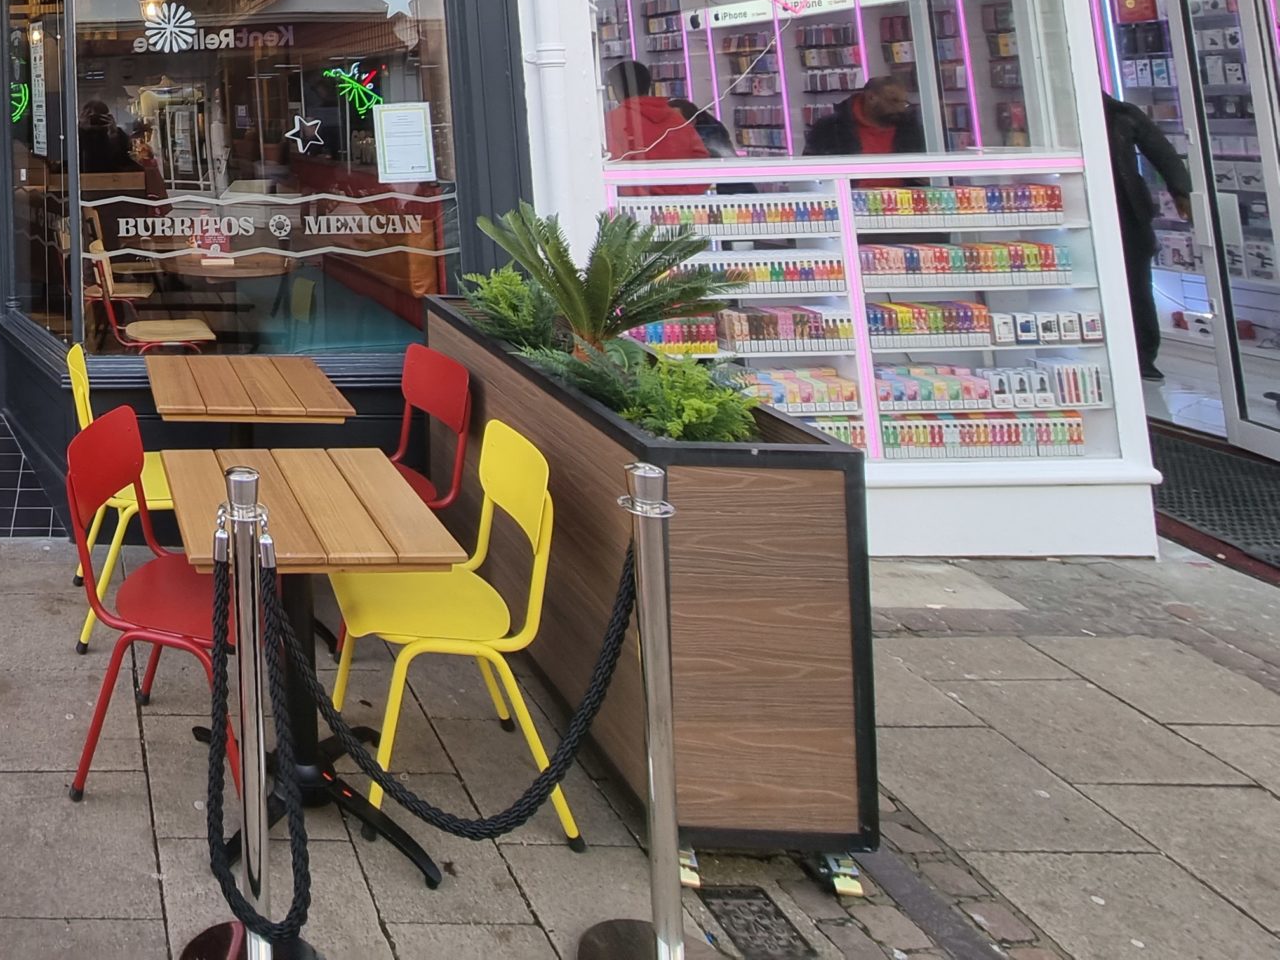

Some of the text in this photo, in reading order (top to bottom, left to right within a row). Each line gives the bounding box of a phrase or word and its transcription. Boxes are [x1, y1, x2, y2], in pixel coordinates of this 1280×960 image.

[721, 11, 748, 21] iPhone
[117, 214, 422, 237] BURRITOS MEXICAN
